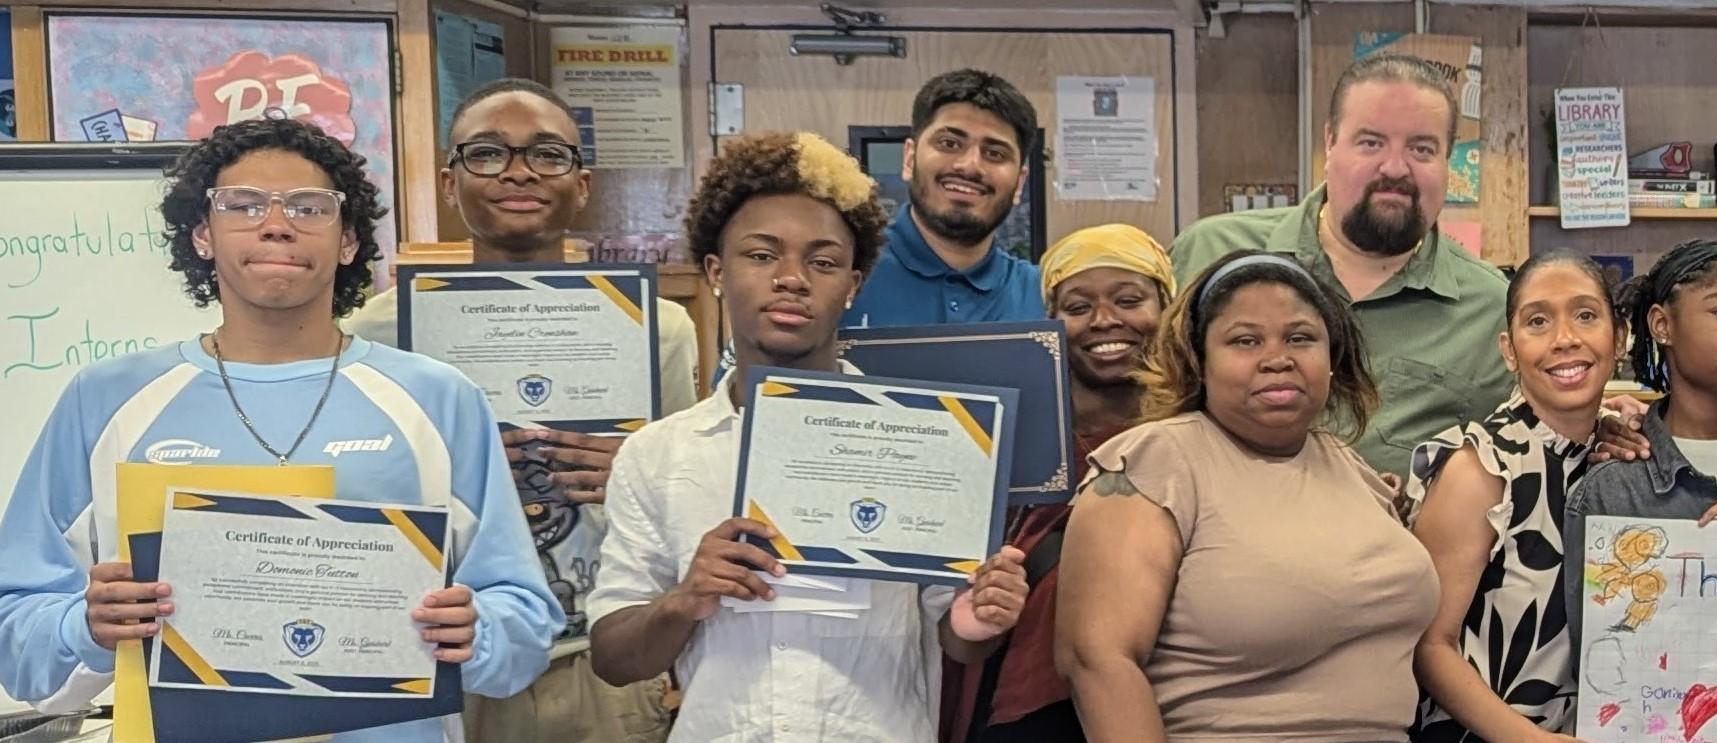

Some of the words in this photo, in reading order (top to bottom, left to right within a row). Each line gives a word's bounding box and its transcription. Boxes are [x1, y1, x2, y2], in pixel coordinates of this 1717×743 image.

[558, 50, 603, 63] FIRE
[608, 50, 668, 63] DRILL
[1559, 104, 1620, 121] LIBRARY
[1577, 164, 1611, 175] special
[461, 304, 517, 315] Certificate
[520, 304, 530, 313] of
[533, 304, 600, 316] Appreciation
[804, 415, 861, 429] Certificate
[864, 420, 875, 429] of
[877, 421, 949, 437] Appreciation
[322, 434, 393, 457] goal
[226, 530, 293, 546] Certificate
[296, 536, 311, 547] of
[312, 537, 394, 552] Appreciation
